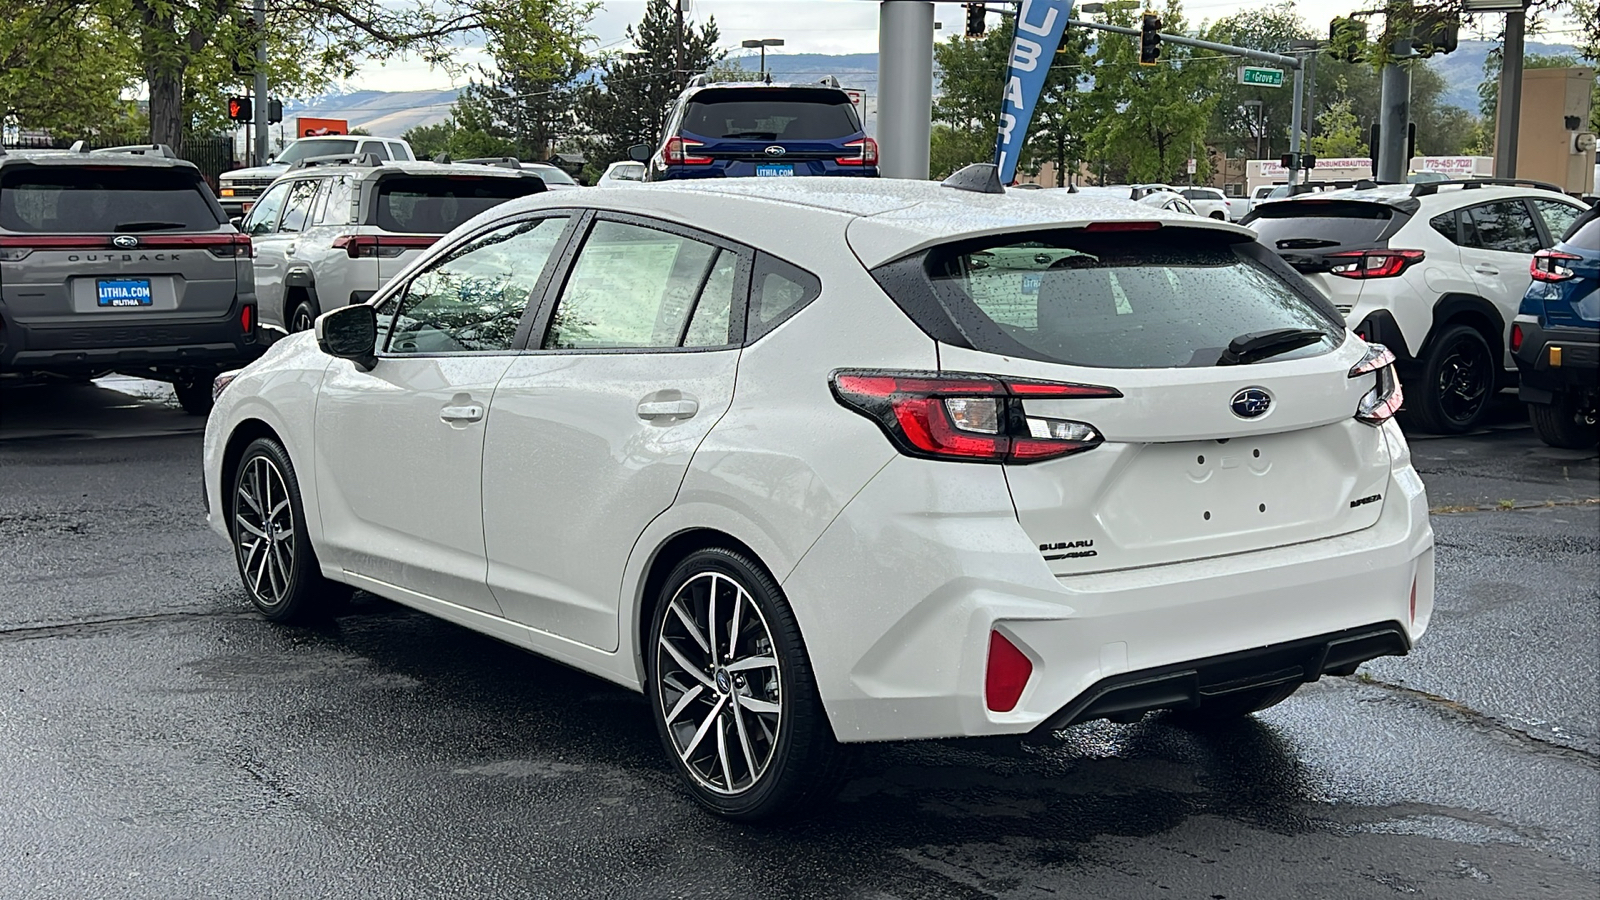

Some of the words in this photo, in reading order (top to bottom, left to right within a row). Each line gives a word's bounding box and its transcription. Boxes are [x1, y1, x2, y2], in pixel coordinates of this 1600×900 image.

[1255, 71, 1273, 83] Grove
[1425, 159, 1472, 168] 775-451-7021
[756, 168, 794, 177] LITHIA.COM
[68, 254, 180, 262] OUTBACK
[99, 287, 150, 298] LITHIA.COM
[1039, 539, 1093, 551] SUBARU
